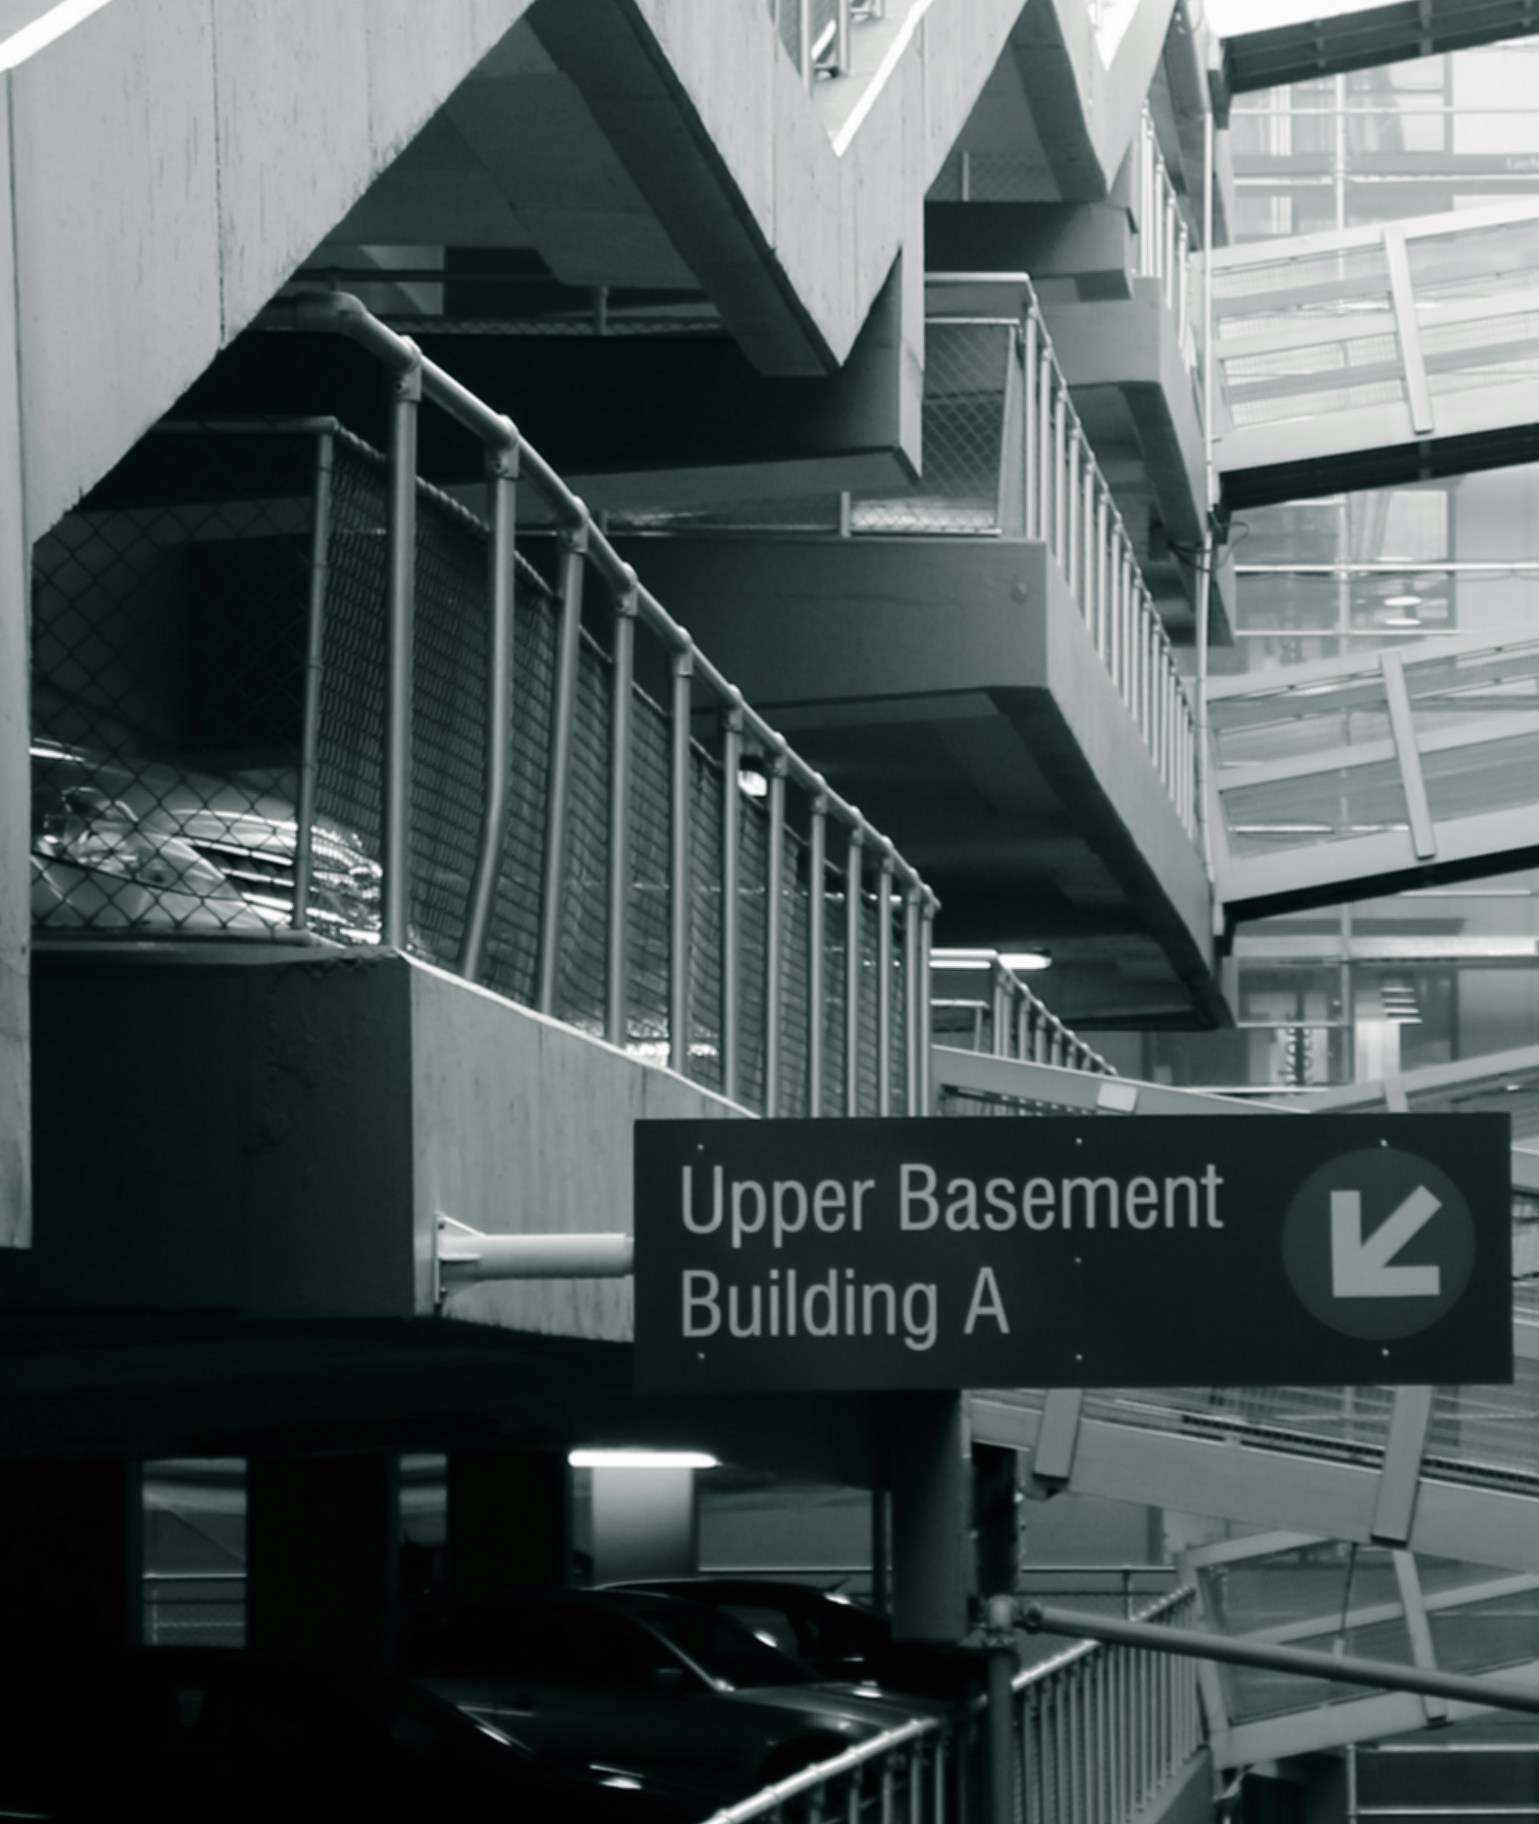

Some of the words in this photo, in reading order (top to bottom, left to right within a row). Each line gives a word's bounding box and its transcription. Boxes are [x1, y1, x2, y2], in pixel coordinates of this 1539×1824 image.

[682, 1165, 875, 1249] Upper
[899, 1162, 1224, 1232] Basement
[682, 1266, 938, 1351] Building
[963, 1266, 1010, 1335] A
